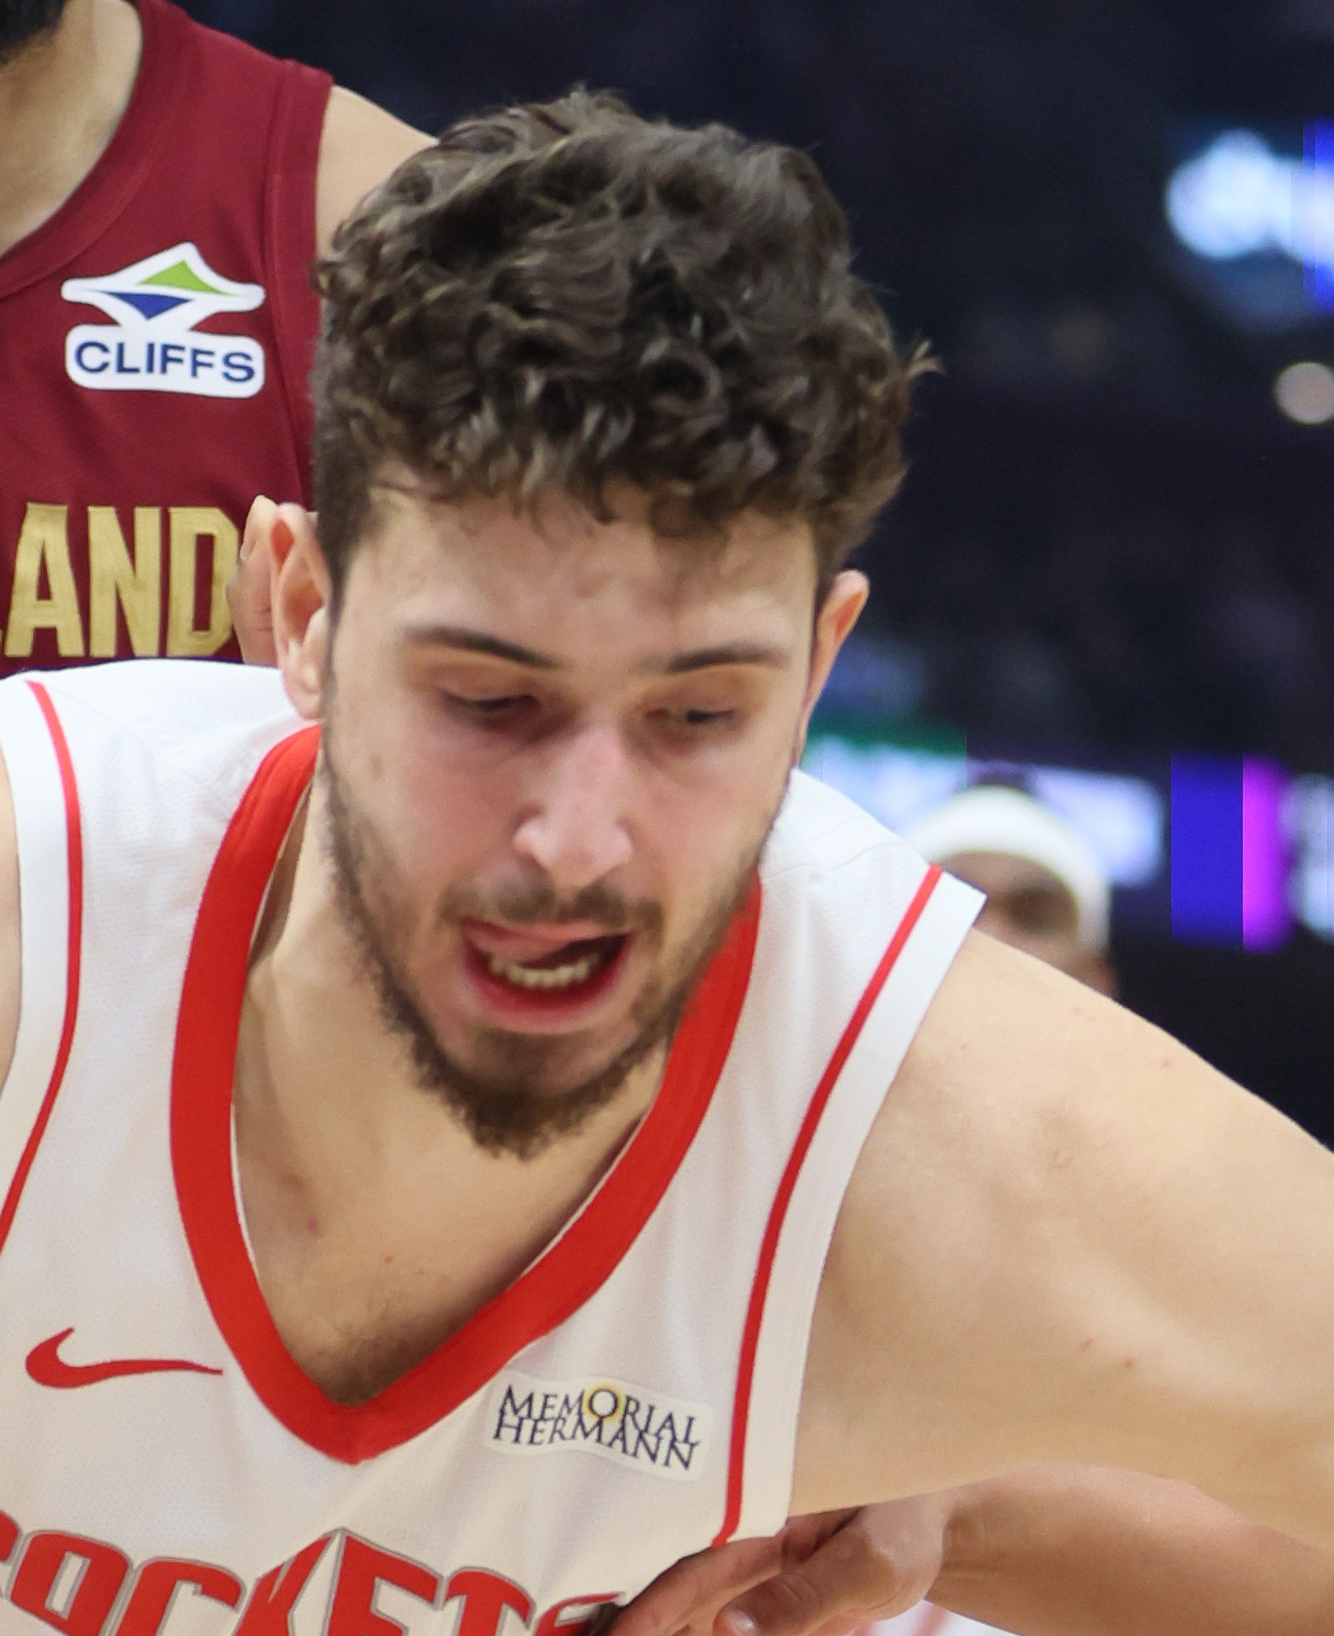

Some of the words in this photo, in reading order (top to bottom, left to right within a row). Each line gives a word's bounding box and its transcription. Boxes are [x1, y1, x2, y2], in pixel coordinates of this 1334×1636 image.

[73, 340, 257, 384] CLIFFS
[493, 1408, 697, 1471] HERMANN
[498, 1383, 700, 1448] MEMORIAL
